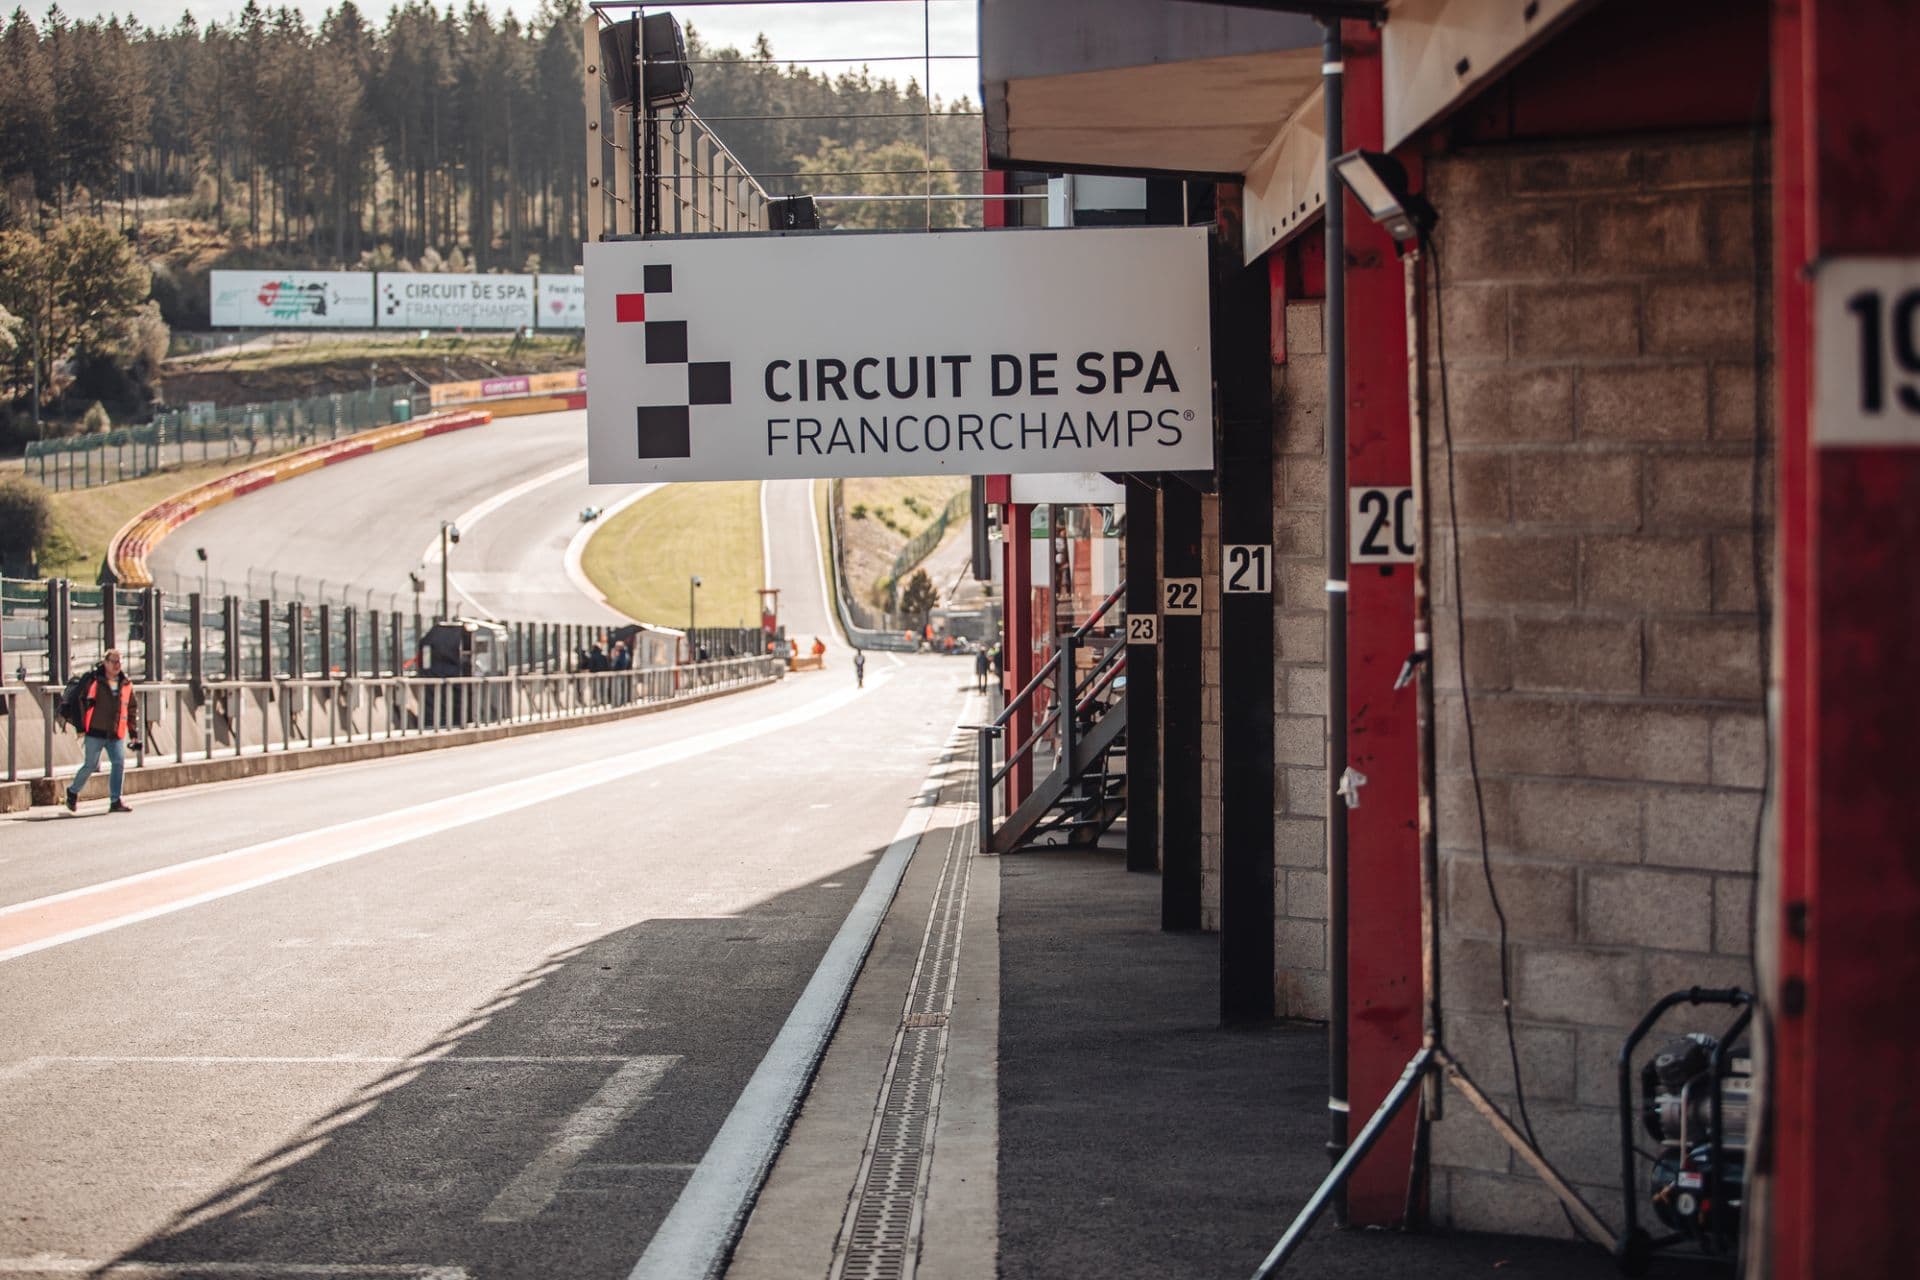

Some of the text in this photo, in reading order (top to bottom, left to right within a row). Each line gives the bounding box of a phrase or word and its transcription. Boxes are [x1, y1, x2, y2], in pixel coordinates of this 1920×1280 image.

[405, 283, 527, 300] CIRCUIT DE SPA
[764, 350, 1180, 402] CIRCUIT DE SPA
[1359, 489, 1415, 556] 20
[1228, 546, 1265, 591] 21
[1166, 583, 1198, 609] 22
[1130, 618, 1154, 639] 23
